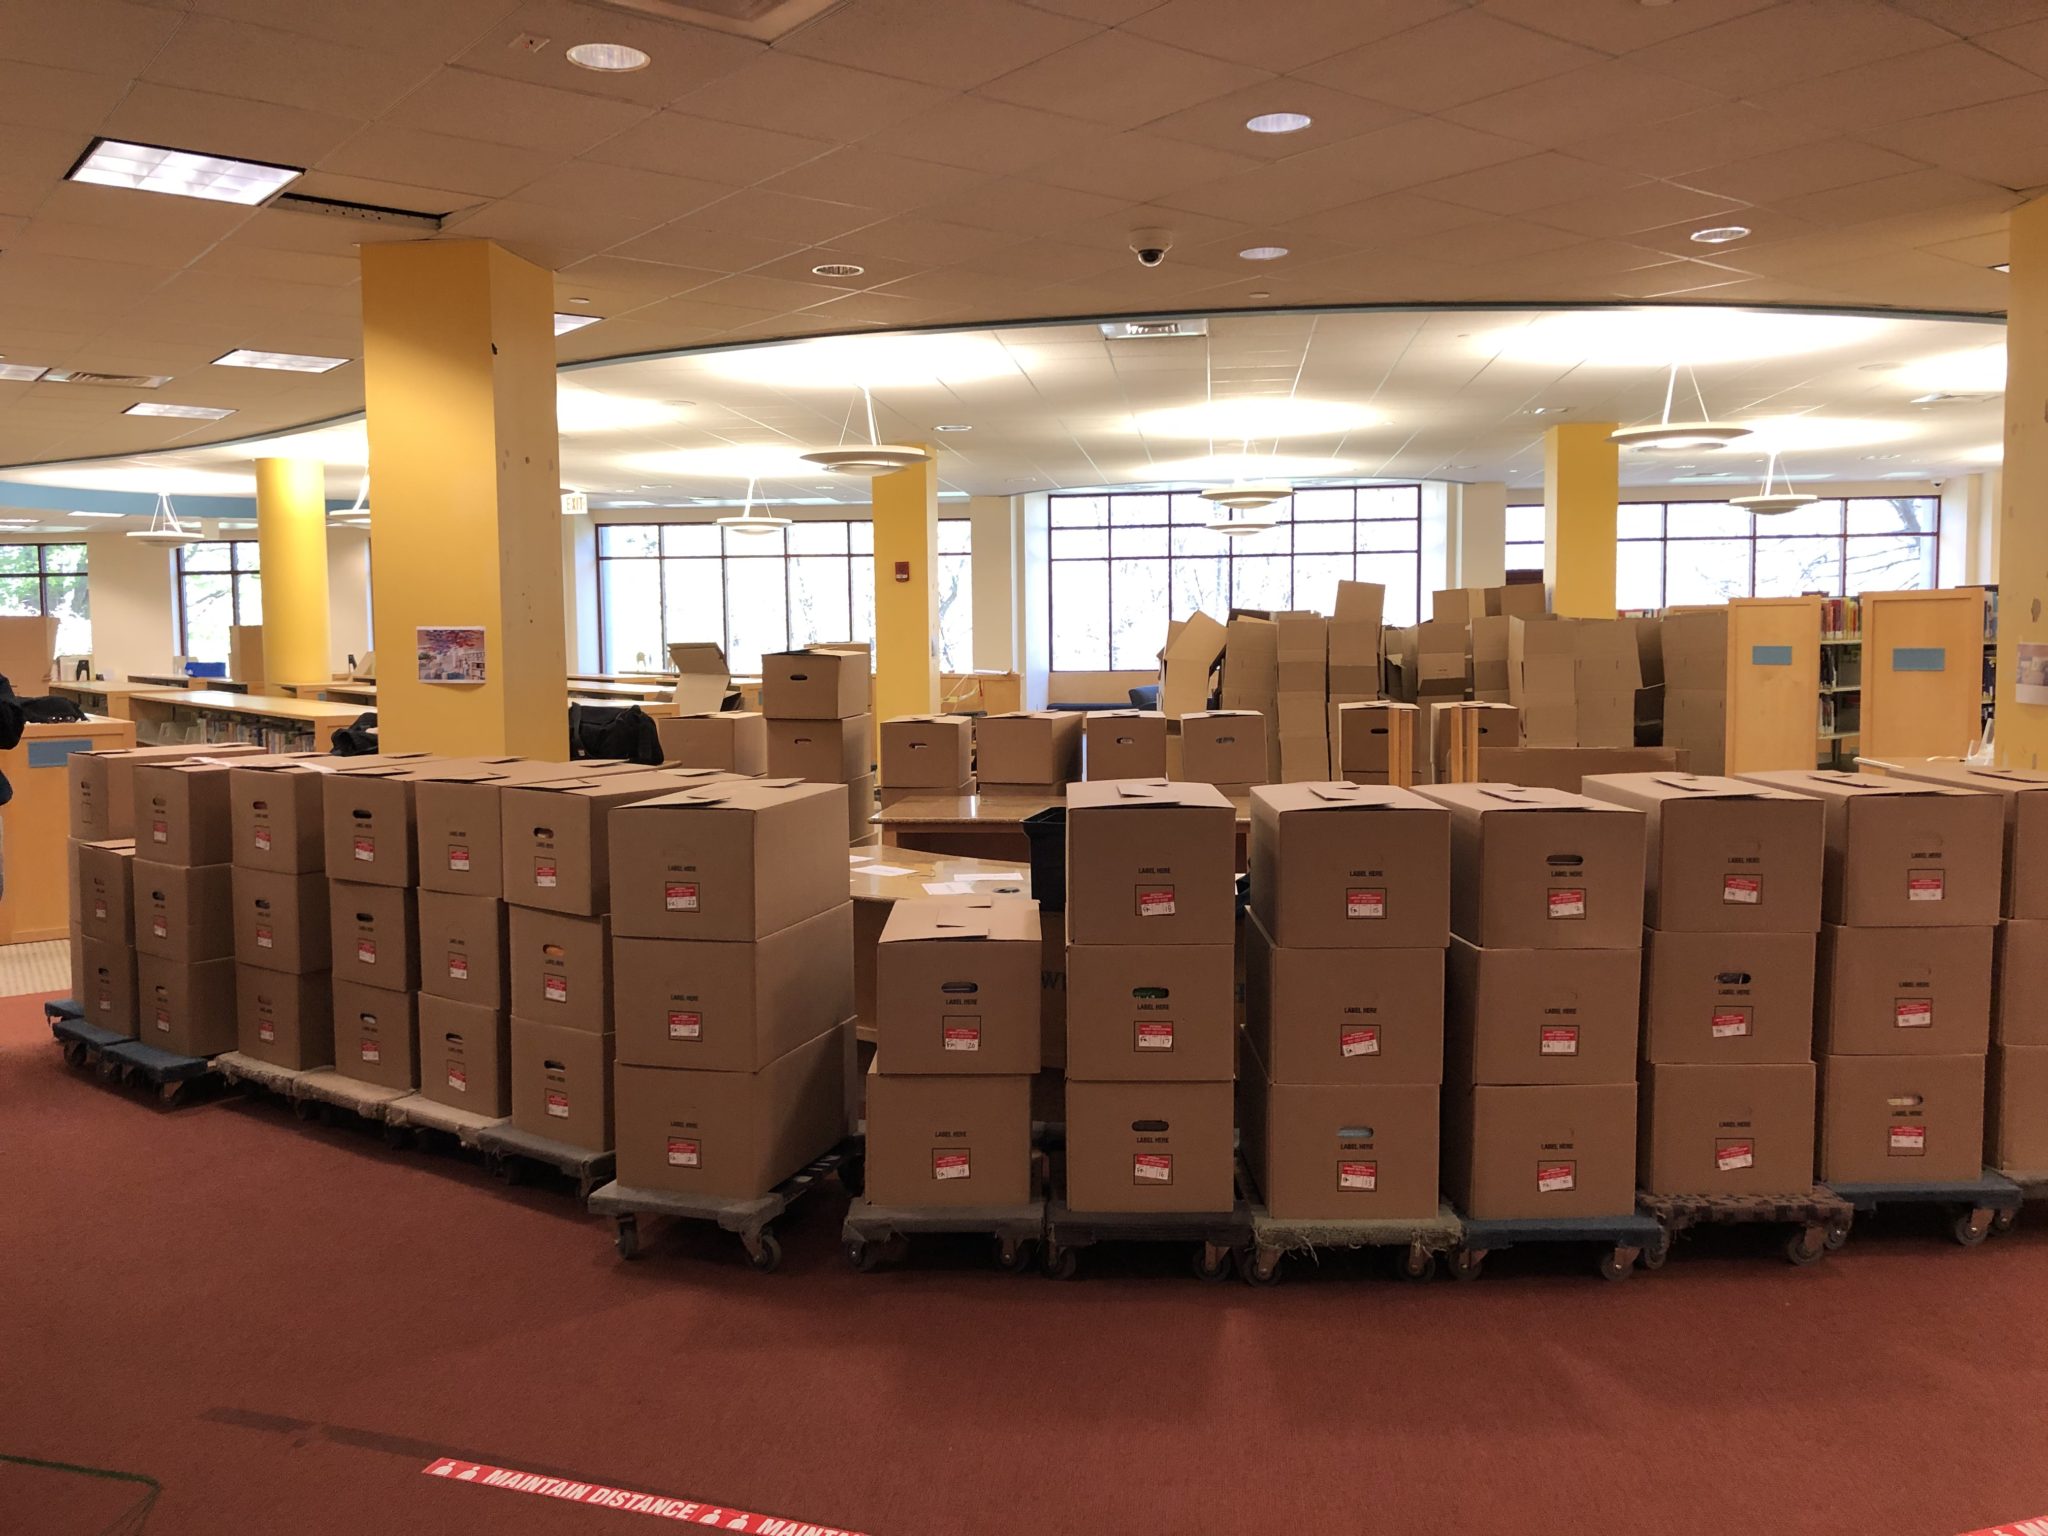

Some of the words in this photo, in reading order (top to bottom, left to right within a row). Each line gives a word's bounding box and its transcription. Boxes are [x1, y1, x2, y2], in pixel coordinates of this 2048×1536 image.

[566, 496, 584, 511] EXIT
[483, 1470, 592, 1500] MAINTAIN
[587, 1488, 699, 1519] DISTANCE
